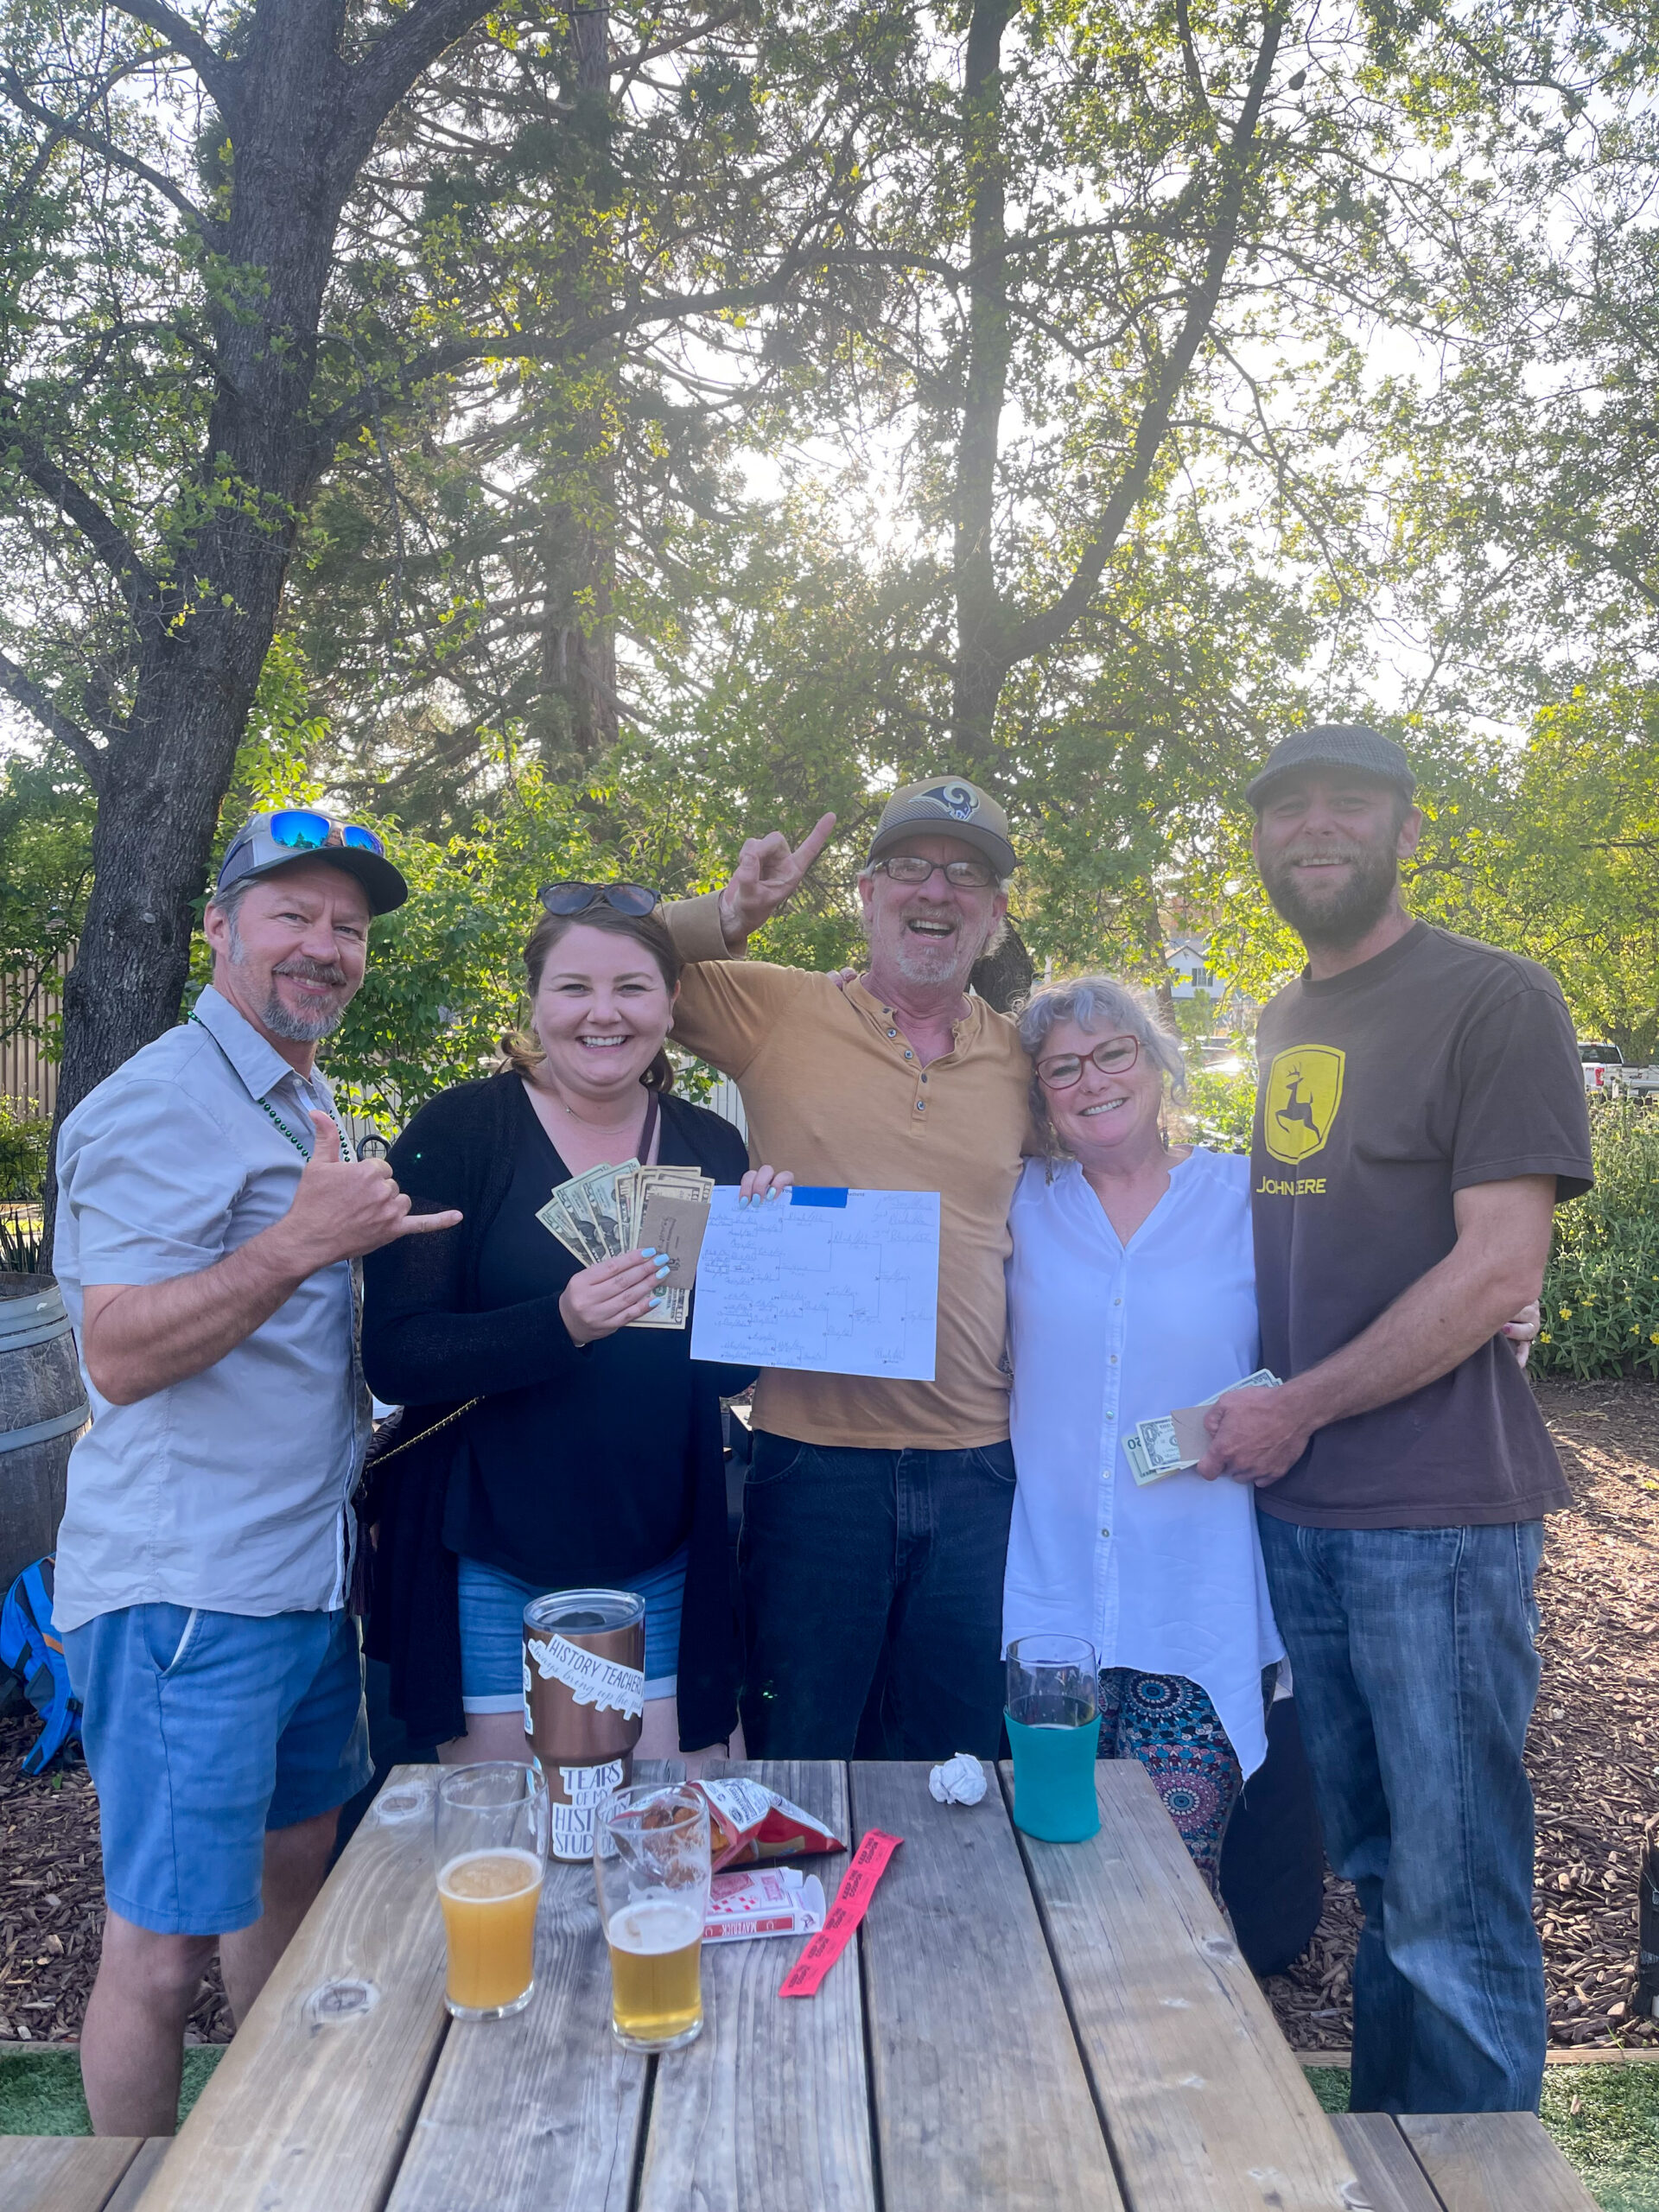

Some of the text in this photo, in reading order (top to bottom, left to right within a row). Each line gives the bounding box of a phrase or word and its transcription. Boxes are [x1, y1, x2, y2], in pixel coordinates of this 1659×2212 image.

[1255, 1176, 1327, 1196] JOHN ERE
[549, 1638, 602, 1678] HISTORY
[563, 1669, 595, 1700] bring
[597, 1689, 614, 1710] up
[564, 1761, 620, 1790] TEARS
[575, 1789, 608, 1806] OF MY
[857, 1850, 868, 1865] KEEP
[864, 1841, 879, 1864] COUPON
[849, 1873, 863, 1897] COUPON
[721, 1921, 757, 1936] MAVERICK
